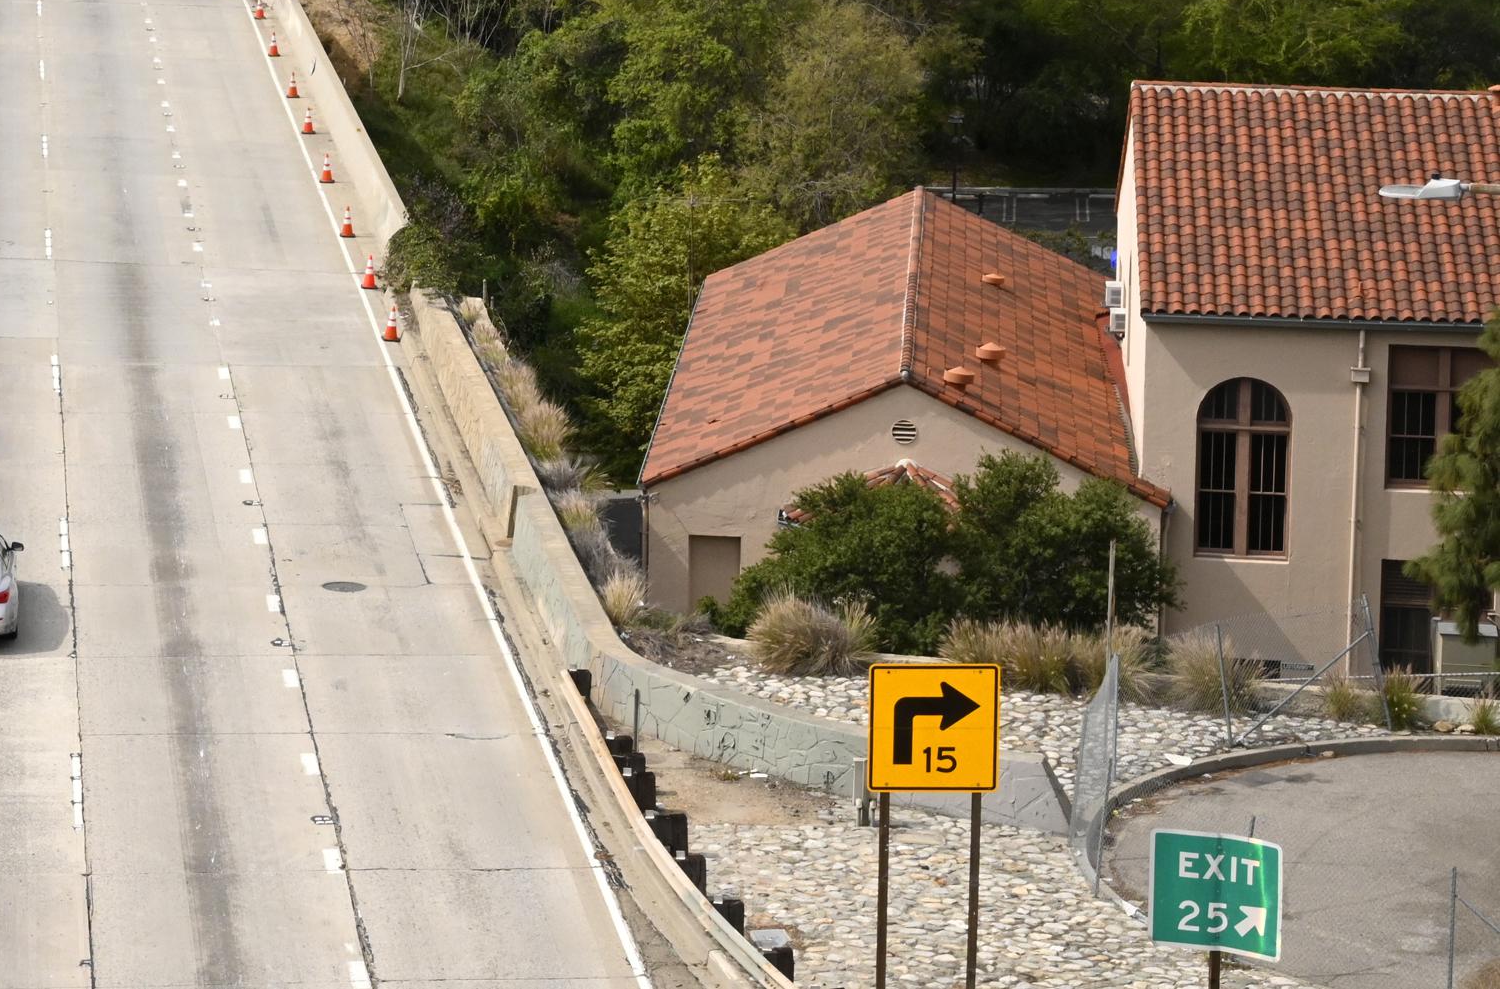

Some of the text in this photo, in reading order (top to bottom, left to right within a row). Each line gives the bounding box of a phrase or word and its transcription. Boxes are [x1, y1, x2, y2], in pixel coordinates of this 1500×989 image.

[922, 746, 957, 773] 15
[1178, 851, 1260, 885] EXIT
[1177, 899, 1228, 933] 25
